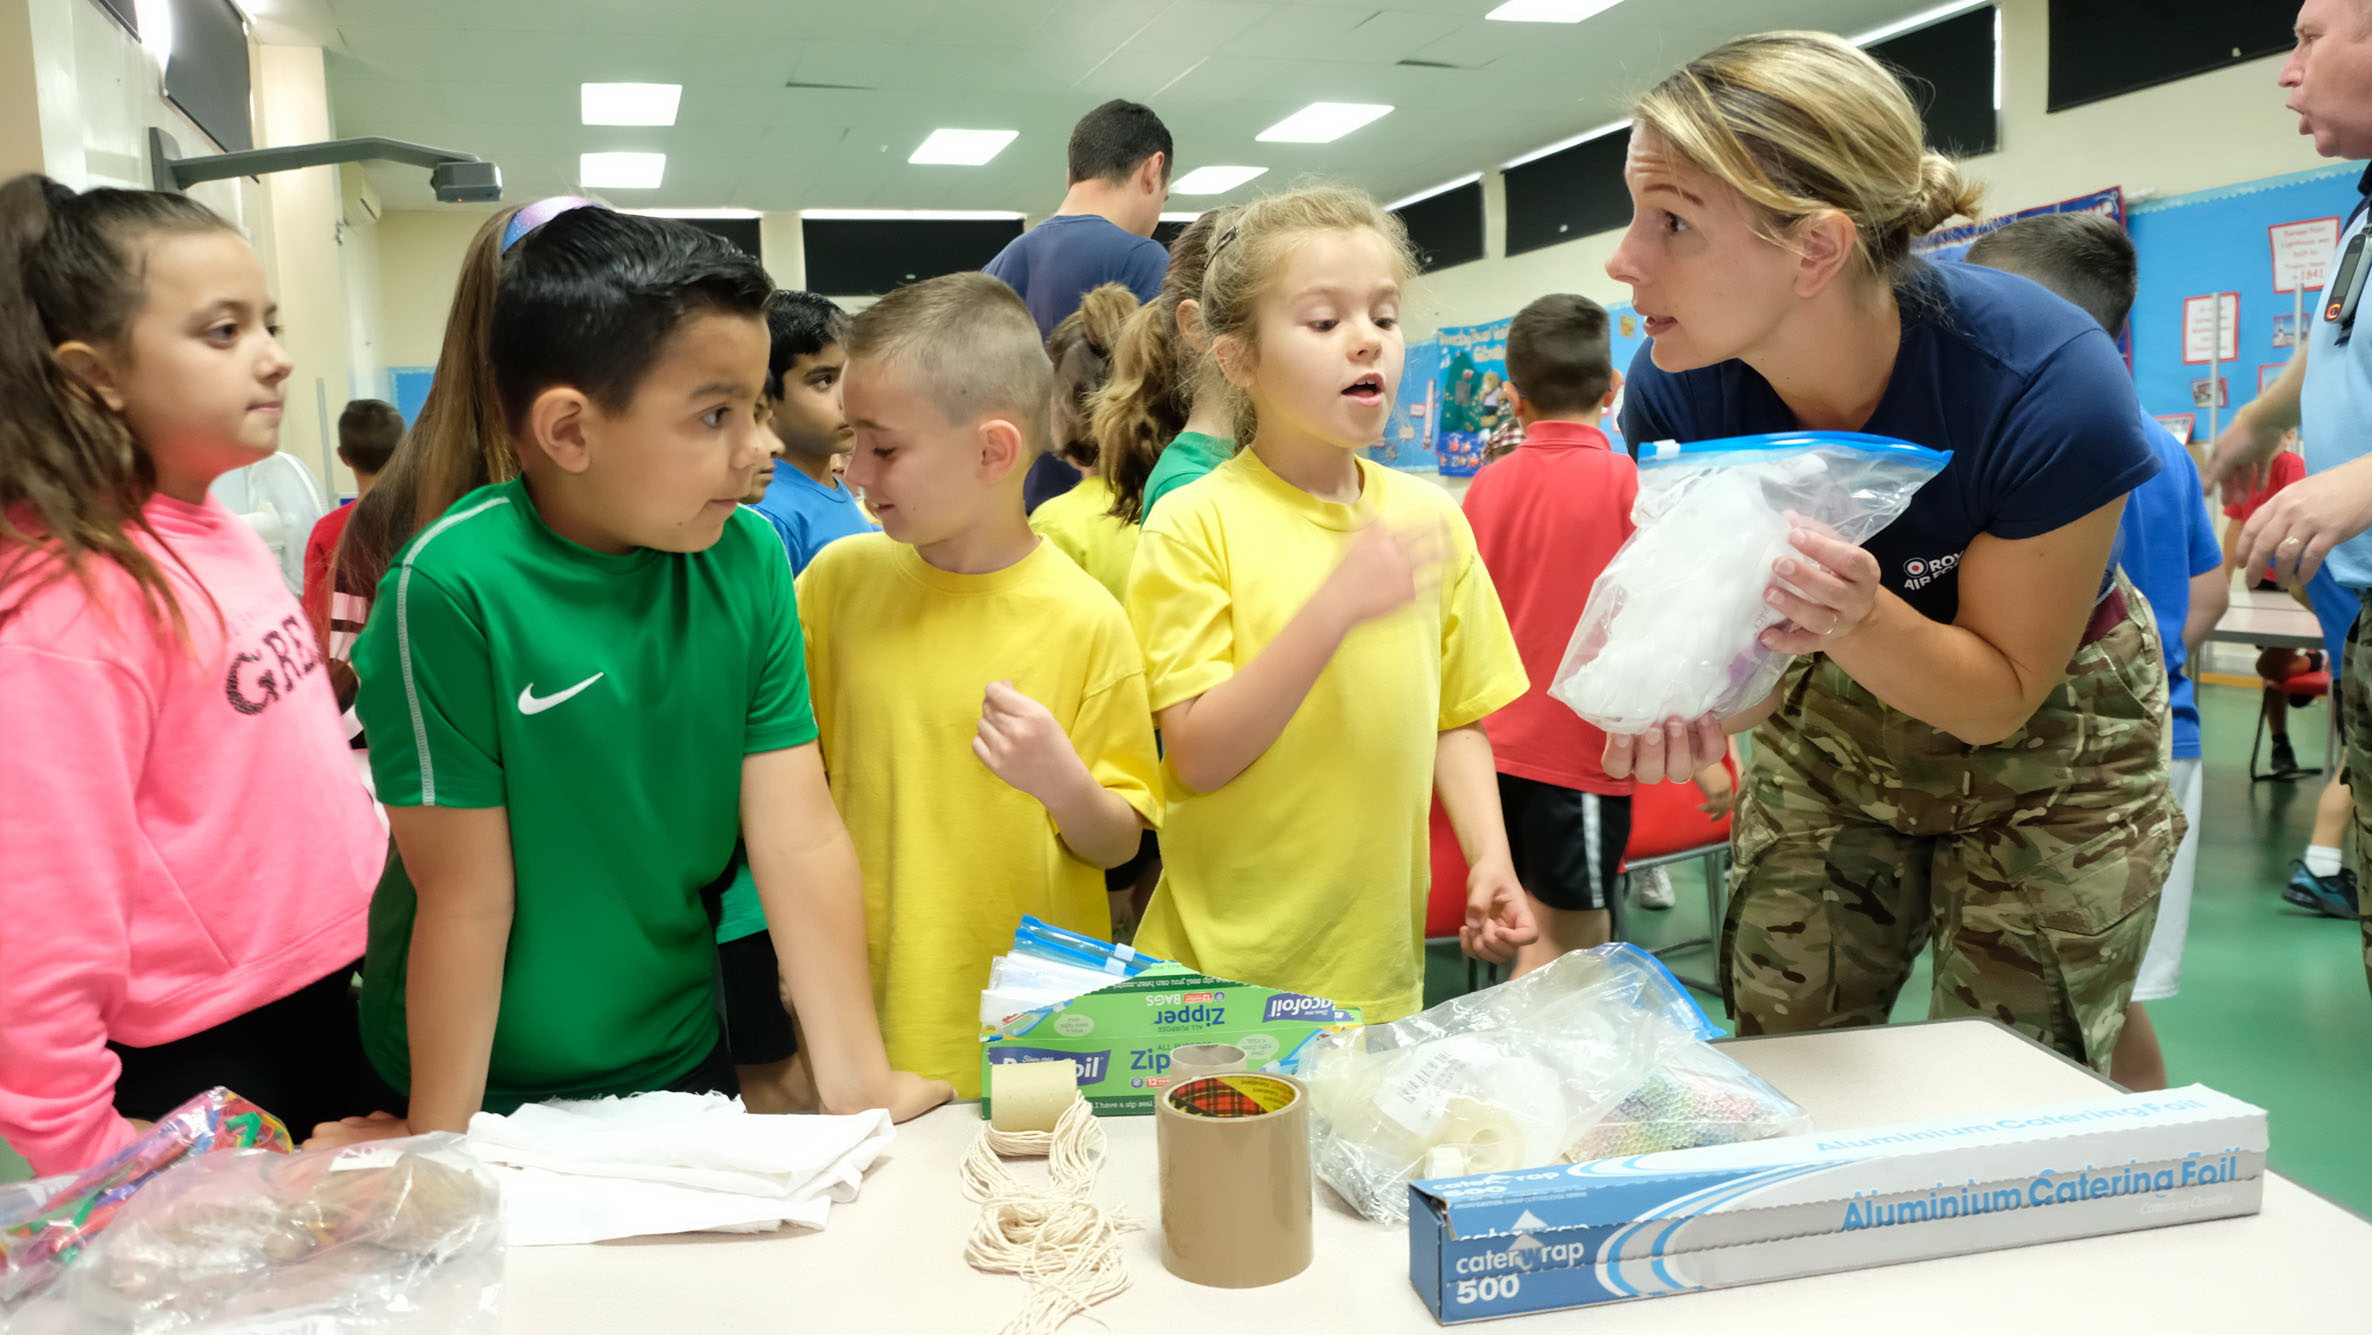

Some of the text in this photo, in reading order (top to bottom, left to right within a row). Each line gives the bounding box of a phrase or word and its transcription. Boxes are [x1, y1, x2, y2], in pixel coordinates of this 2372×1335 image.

[2301, 268, 2324, 281] 1841
[1929, 551, 1964, 572] ROY
[226, 616, 325, 715] GRE
[1145, 993, 1181, 1007] BAGS
[1271, 997, 1335, 1017] acofoil
[1154, 1005, 1225, 1027] Zipper
[1157, 1024, 1189, 1032] PURPOSE
[1130, 1049, 1171, 1074] Zip
[1815, 1098, 2207, 1153] Aluminium Catering Foil
[1842, 1146, 2241, 1232] Aluminium Catering Foil
[1456, 1272, 1520, 1304] 500
